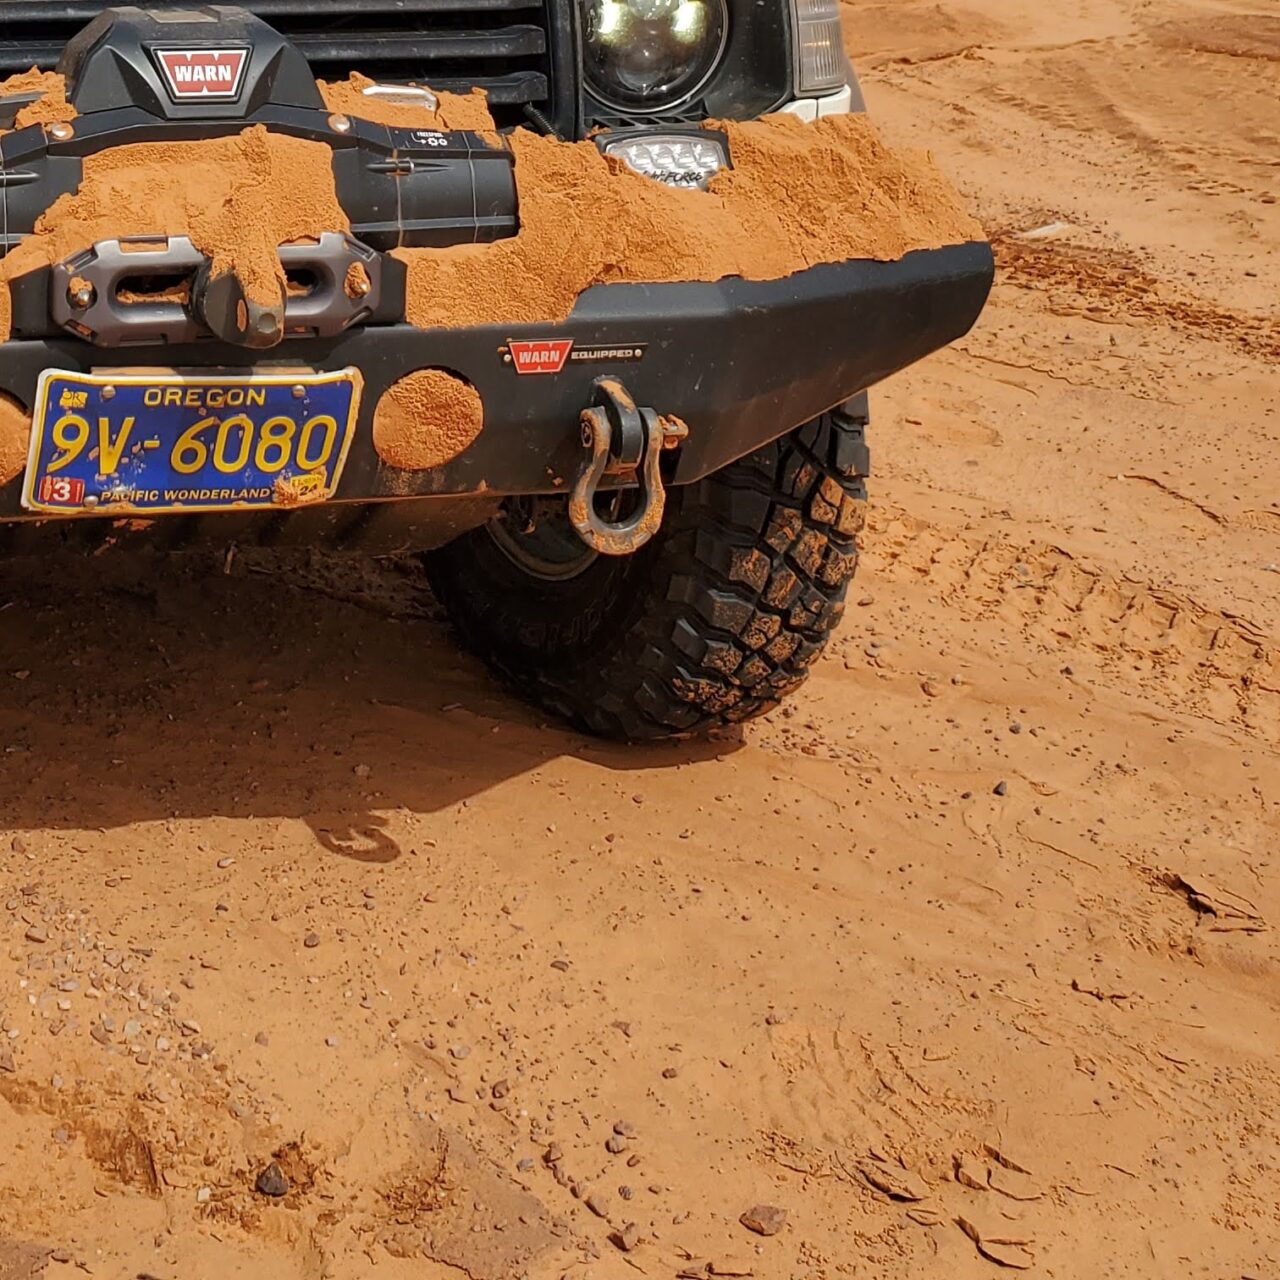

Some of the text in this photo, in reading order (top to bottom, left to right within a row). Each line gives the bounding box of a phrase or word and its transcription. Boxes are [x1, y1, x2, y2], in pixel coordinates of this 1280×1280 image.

[174, 64, 232, 82] WARN
[519, 350, 560, 364] WARN
[571, 349, 633, 360] EQUIPPED
[144, 388, 266, 407] OREGON
[100, 487, 271, 503] PACIFIC WONDERLAND
